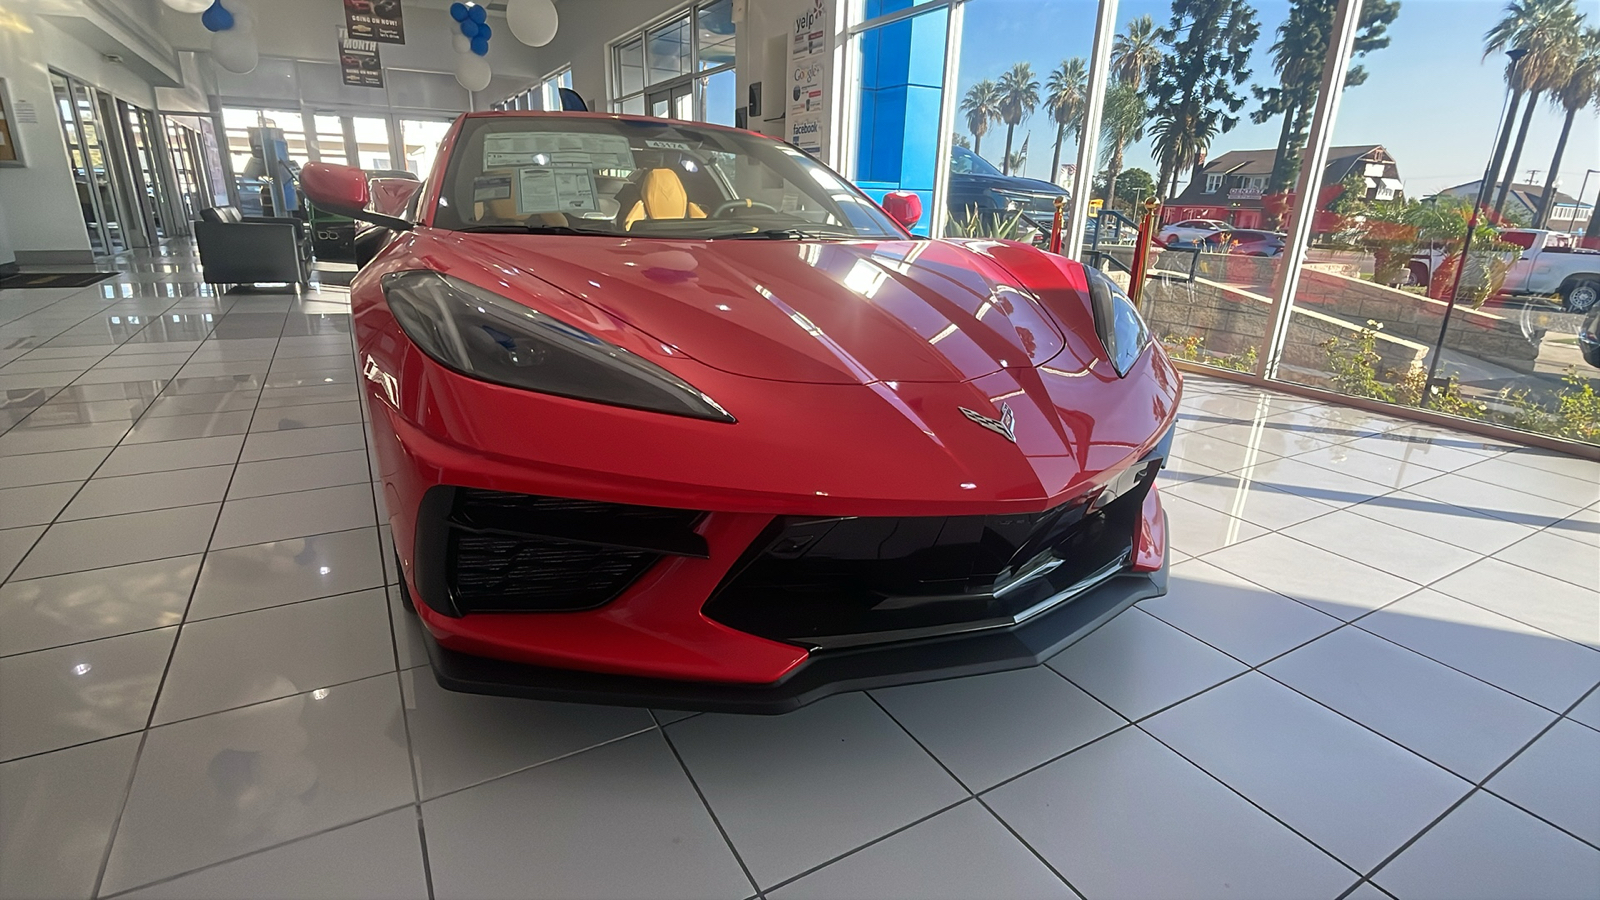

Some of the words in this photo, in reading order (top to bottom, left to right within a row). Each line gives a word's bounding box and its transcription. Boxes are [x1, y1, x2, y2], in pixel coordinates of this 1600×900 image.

[351, 15, 371, 23] GOING
[796, 12, 814, 33] yelp
[343, 39, 377, 52] MONTH
[793, 122, 818, 135] facebook
